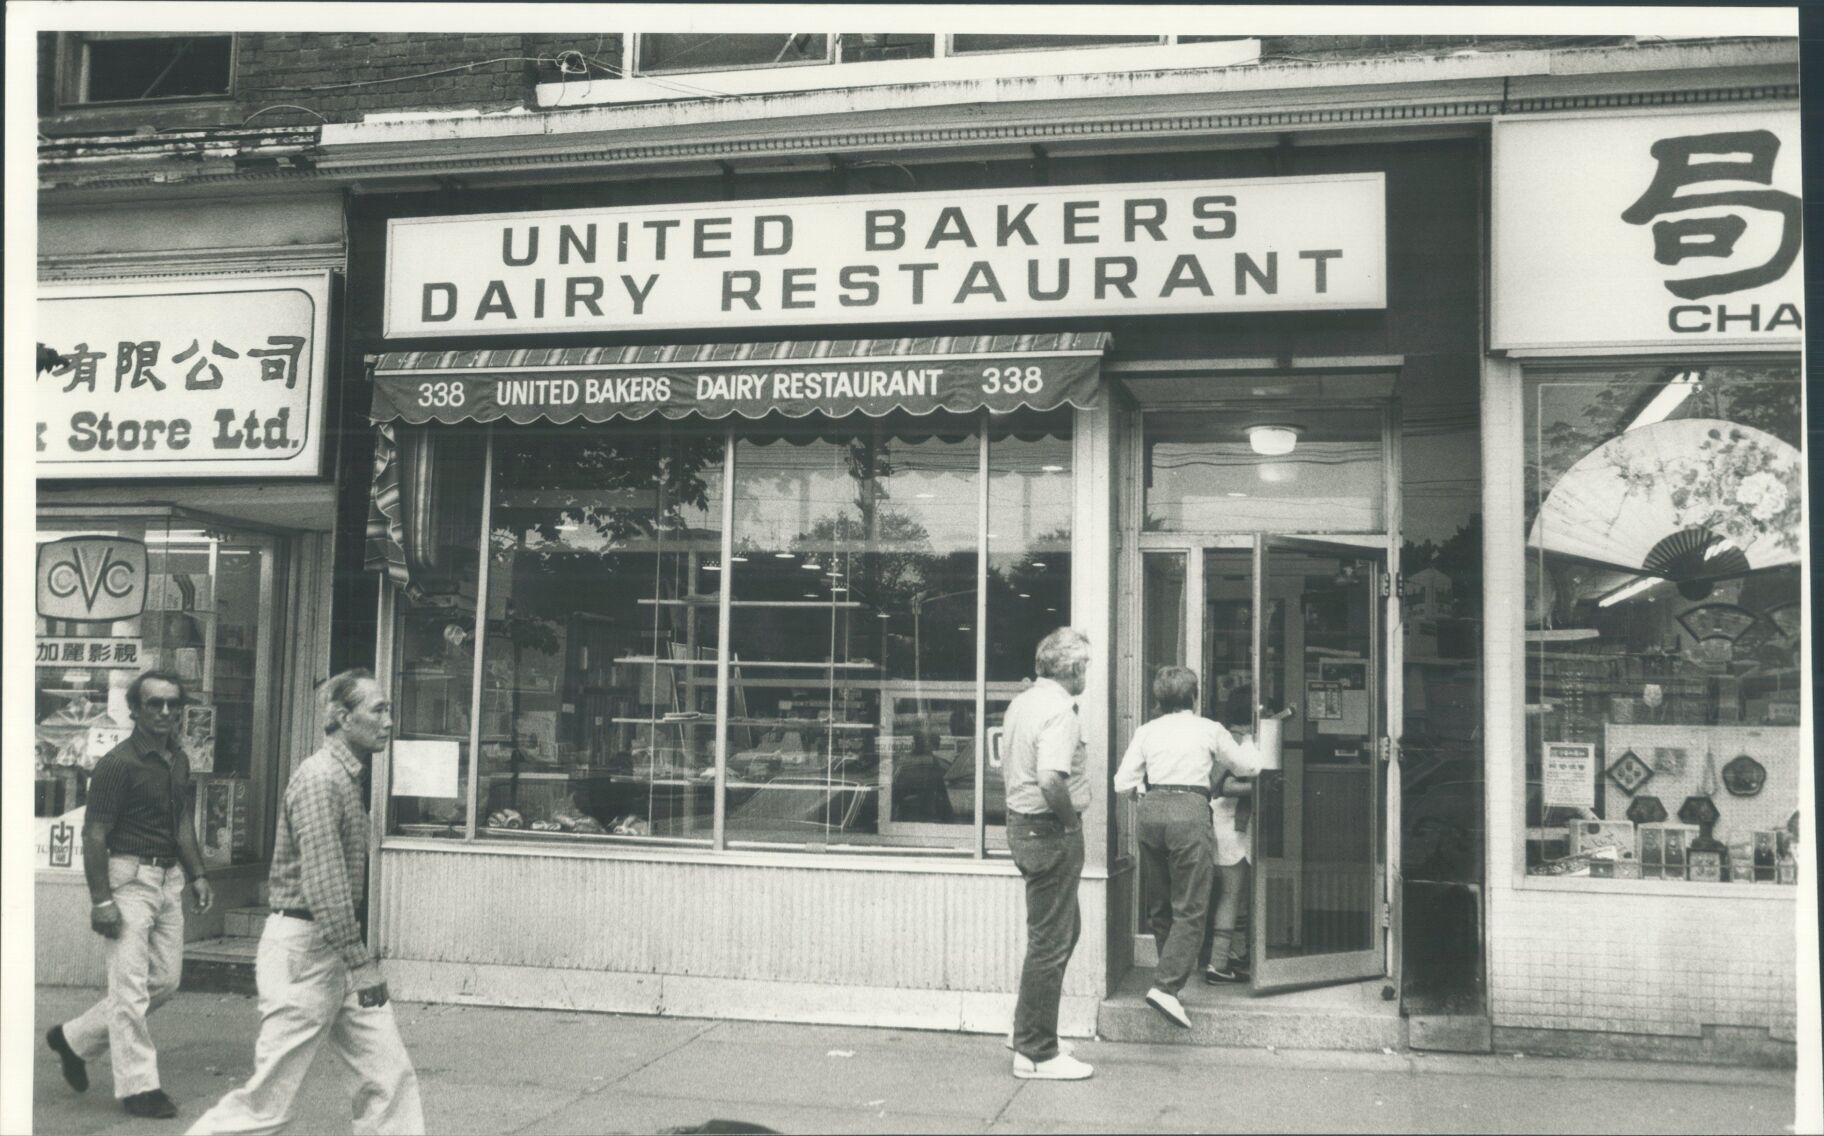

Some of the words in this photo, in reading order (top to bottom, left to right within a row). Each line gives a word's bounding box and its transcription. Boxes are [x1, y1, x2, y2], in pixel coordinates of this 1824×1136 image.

[502, 214, 794, 267] UNITED
[864, 195, 1237, 252] BAKERS
[421, 273, 660, 323] DAIRY
[721, 249, 1343, 312] RESTAURANT
[417, 381, 465, 407] 338
[496, 379, 580, 406] UNITED
[585, 376, 671, 404] BAKERS
[696, 373, 769, 401] DAIRY
[772, 369, 944, 400] RESTAURANT
[981, 366, 1044, 395] 338
[67, 410, 192, 452] Store
[212, 406, 299, 450] Ltd.
[47, 546, 134, 614] CVC
[35, 642, 138, 663] 加麗影視
